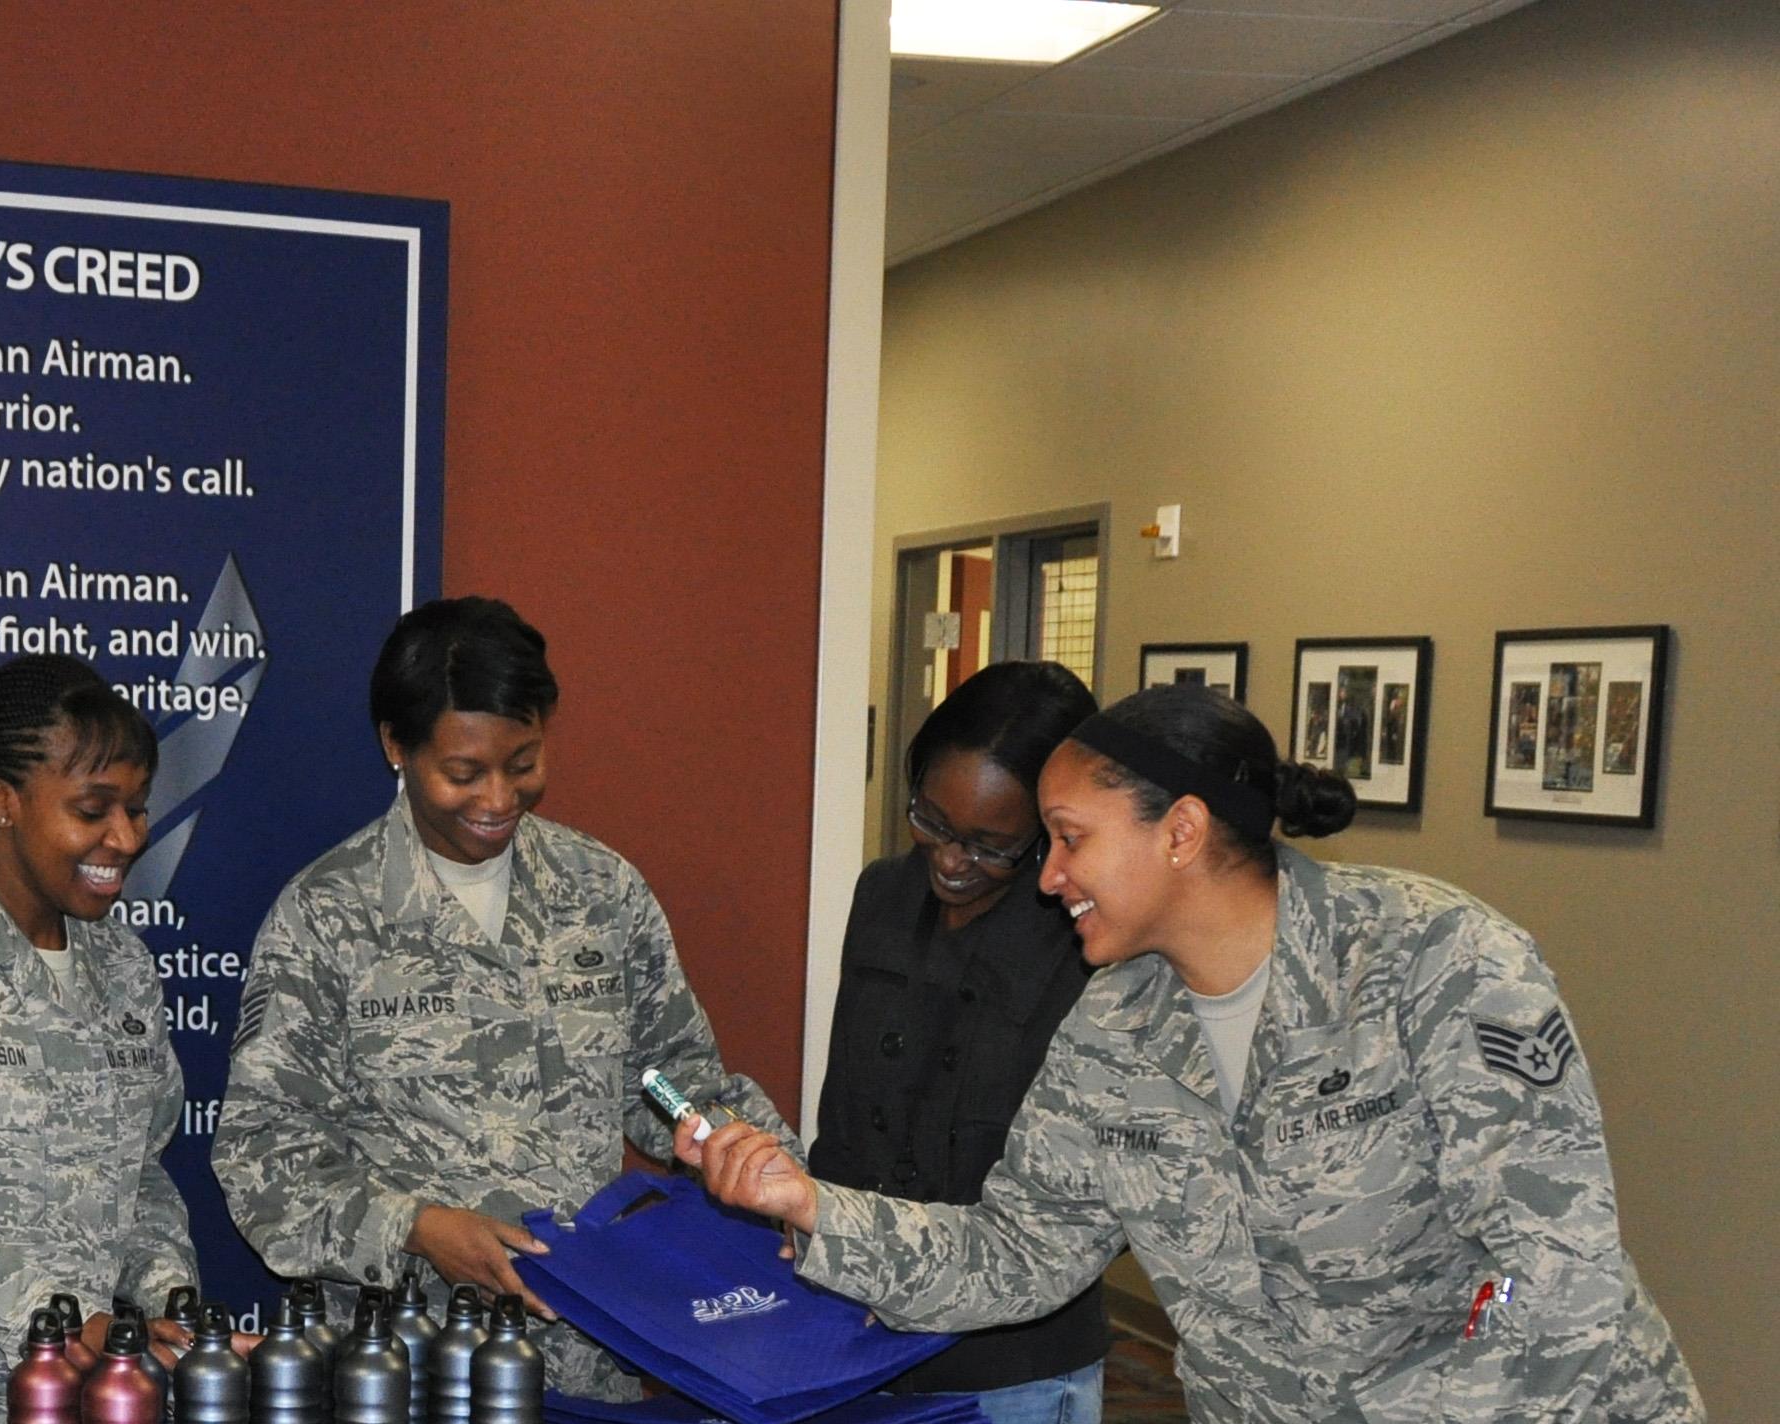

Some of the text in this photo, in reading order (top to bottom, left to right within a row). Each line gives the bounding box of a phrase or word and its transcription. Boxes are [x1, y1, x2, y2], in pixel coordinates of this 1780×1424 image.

[44, 247, 199, 301] CREED
[42, 340, 191, 383] Airman.
[23, 453, 171, 492] nation's
[183, 459, 253, 496] call.
[40, 563, 188, 602] Airman.
[108, 621, 179, 657] and
[191, 625, 265, 660] win.
[112, 681, 250, 718] eritage,
[157, 952, 249, 982] stice,
[361, 996, 455, 1019] EDWARDS
[572, 981, 598, 1001] AIR
[1277, 1091, 1401, 1143] U.S. AIR FORCE
